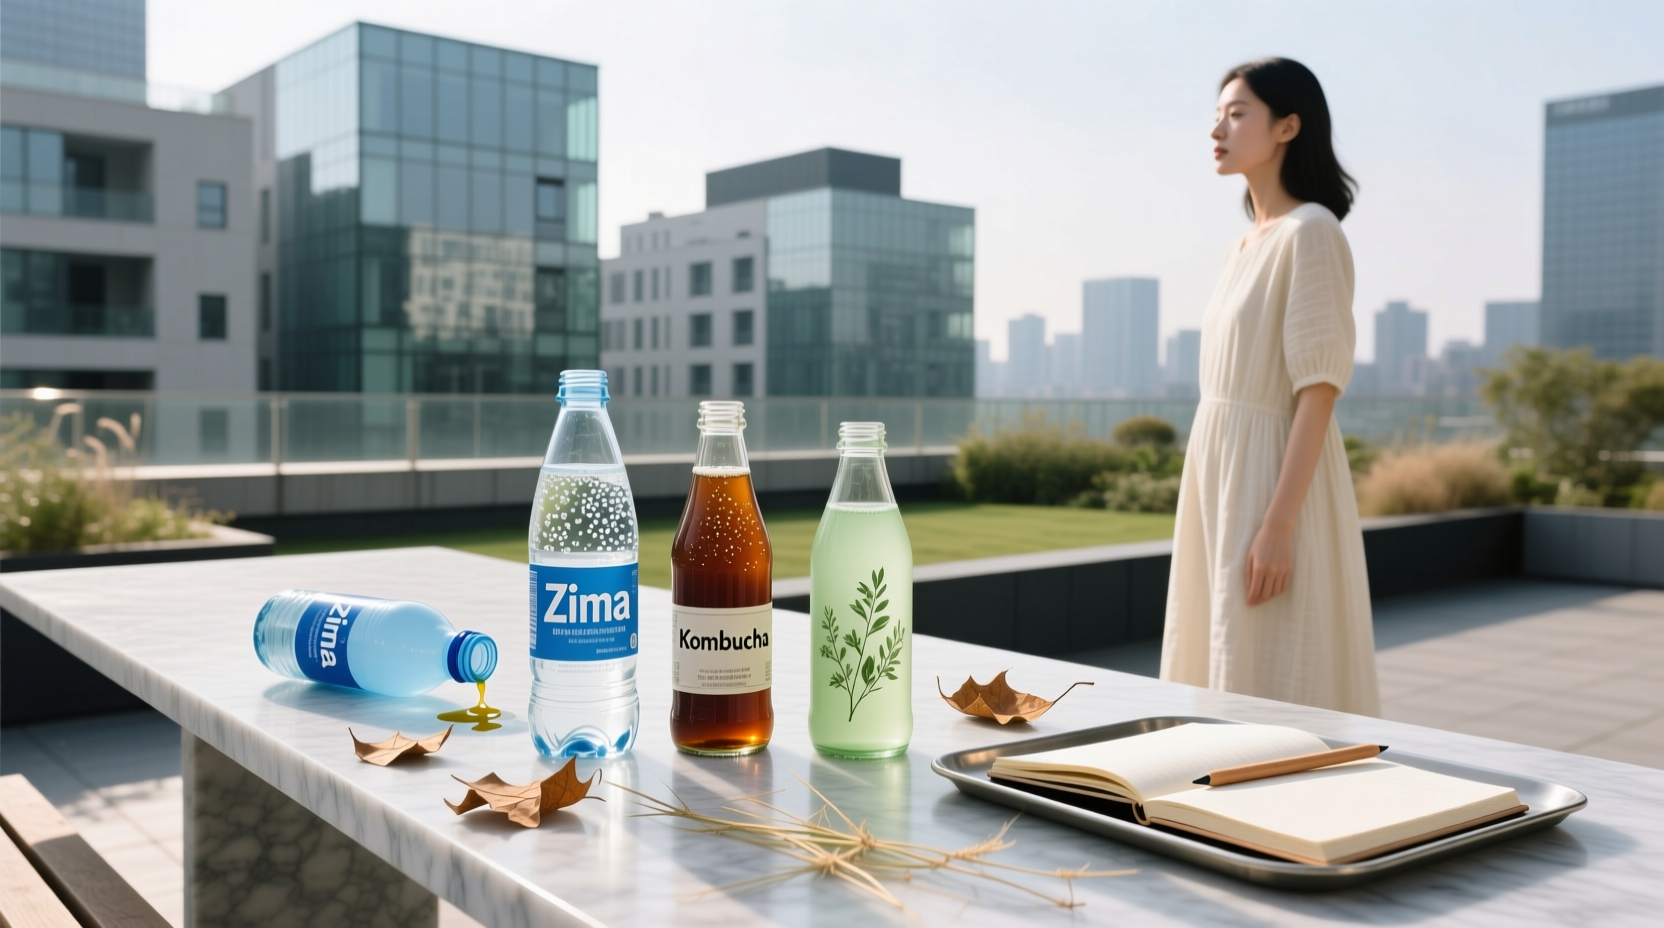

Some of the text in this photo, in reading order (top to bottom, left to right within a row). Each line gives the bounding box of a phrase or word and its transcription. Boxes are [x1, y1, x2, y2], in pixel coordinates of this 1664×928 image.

[543, 583, 630, 624] Zima
[320, 602, 352, 668] Zima
[679, 628, 769, 651] Kombucha
